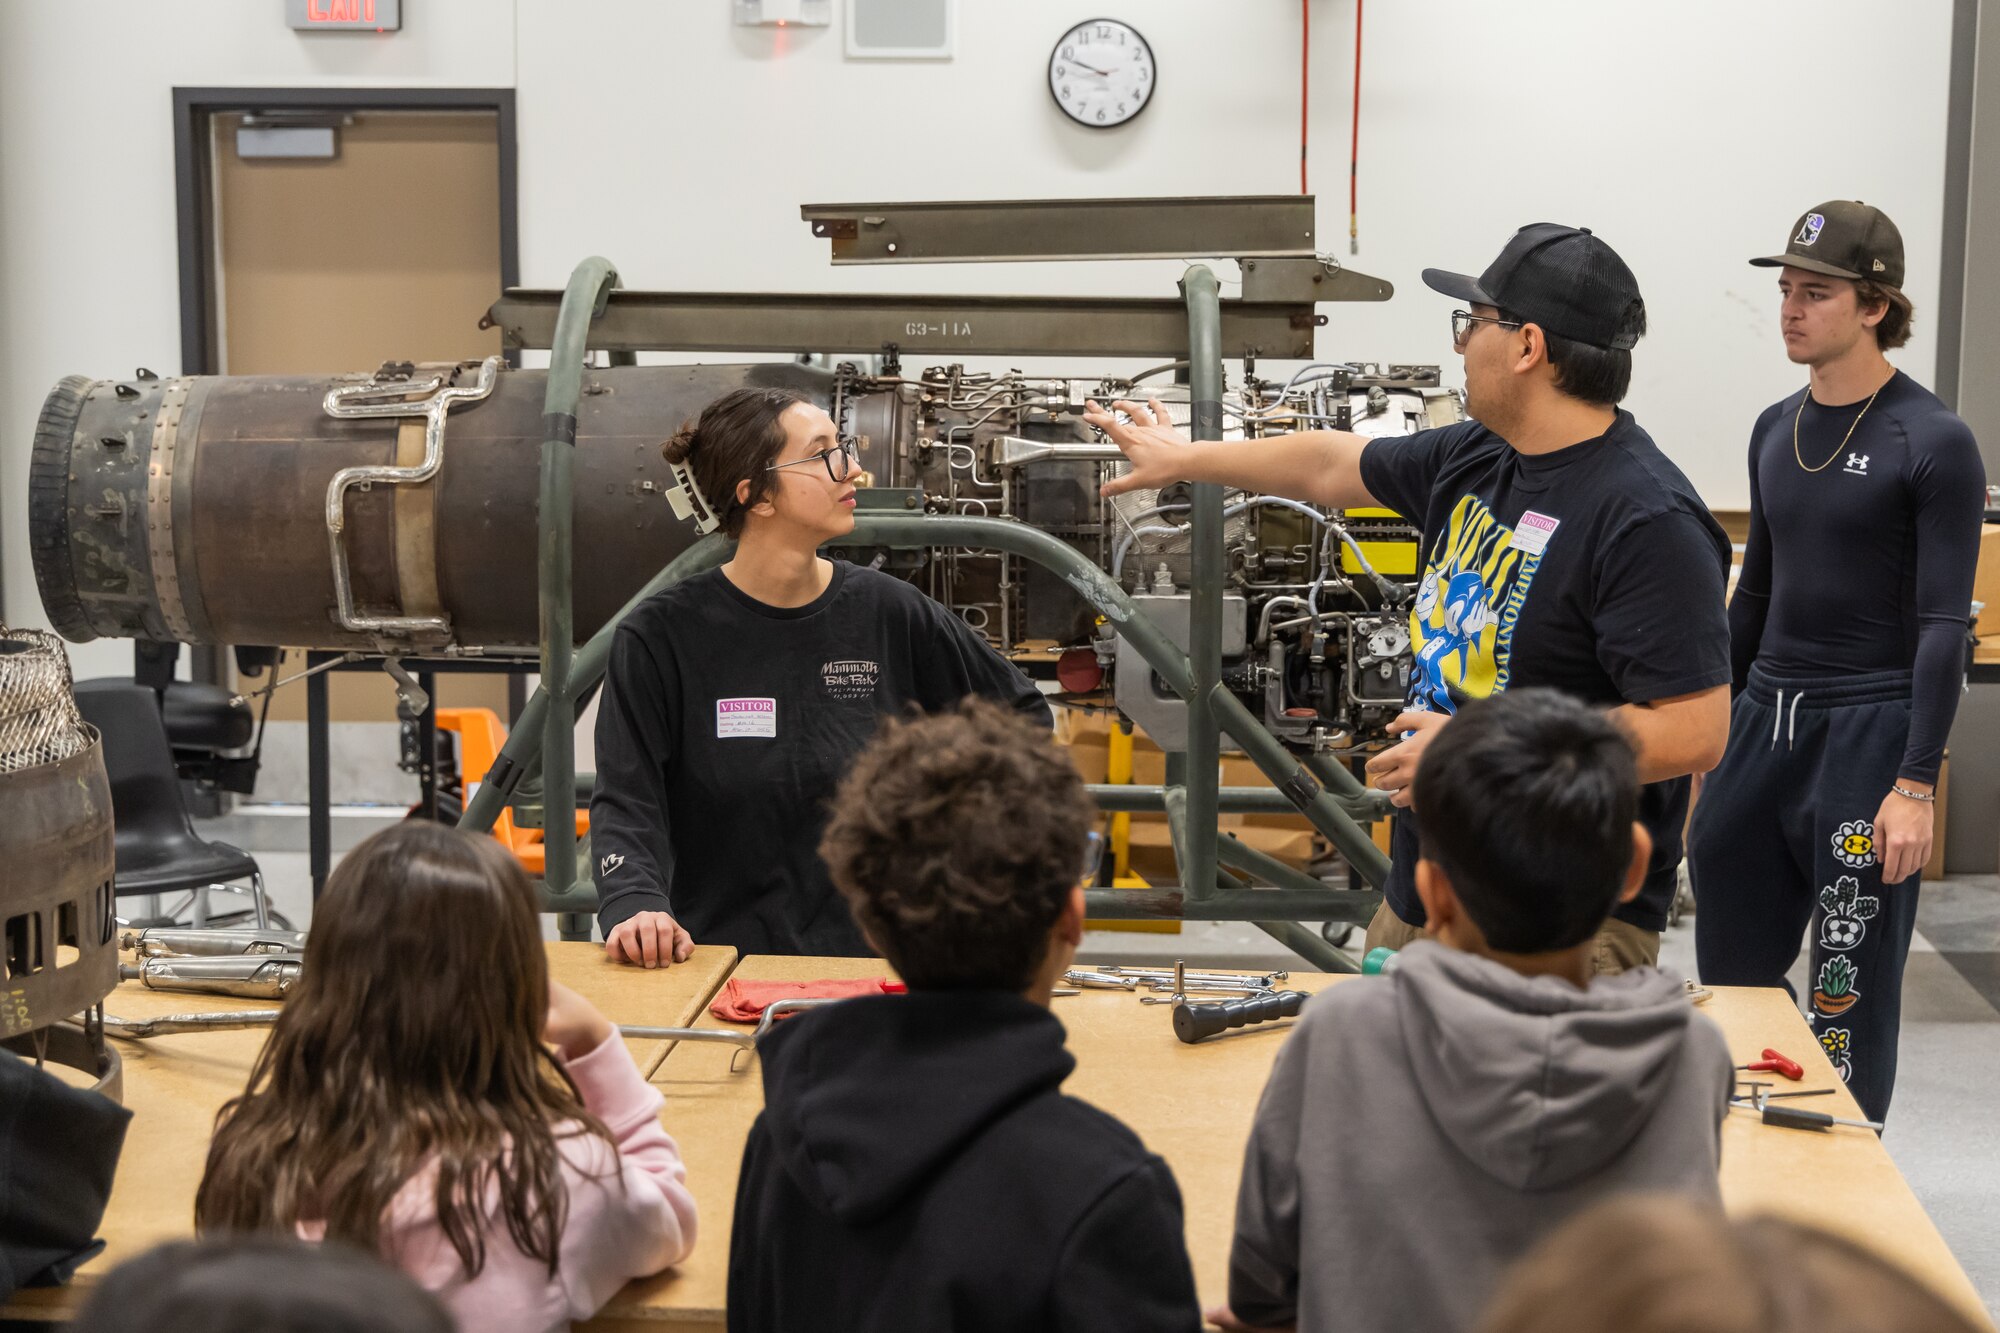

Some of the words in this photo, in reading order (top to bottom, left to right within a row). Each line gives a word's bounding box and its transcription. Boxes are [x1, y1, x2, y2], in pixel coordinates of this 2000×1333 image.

[1078, 30, 1089, 45] 11
[1097, 25, 1112, 39] 12
[1120, 32, 1125, 46] 1
[1061, 45, 1075, 61] 10
[1133, 46, 1142, 61] 2
[1057, 65, 1066, 80] 9
[1139, 67, 1148, 82] 3
[1061, 84, 1071, 100] 8
[1131, 88, 1140, 101] 4
[1078, 101, 1087, 116] 7
[1096, 107, 1106, 122] 6
[1115, 102, 1126, 118] 5
[1523, 514, 1554, 531] VISITOR
[821, 660, 880, 676] Mammoth
[721, 702, 771, 711] VISITOR
